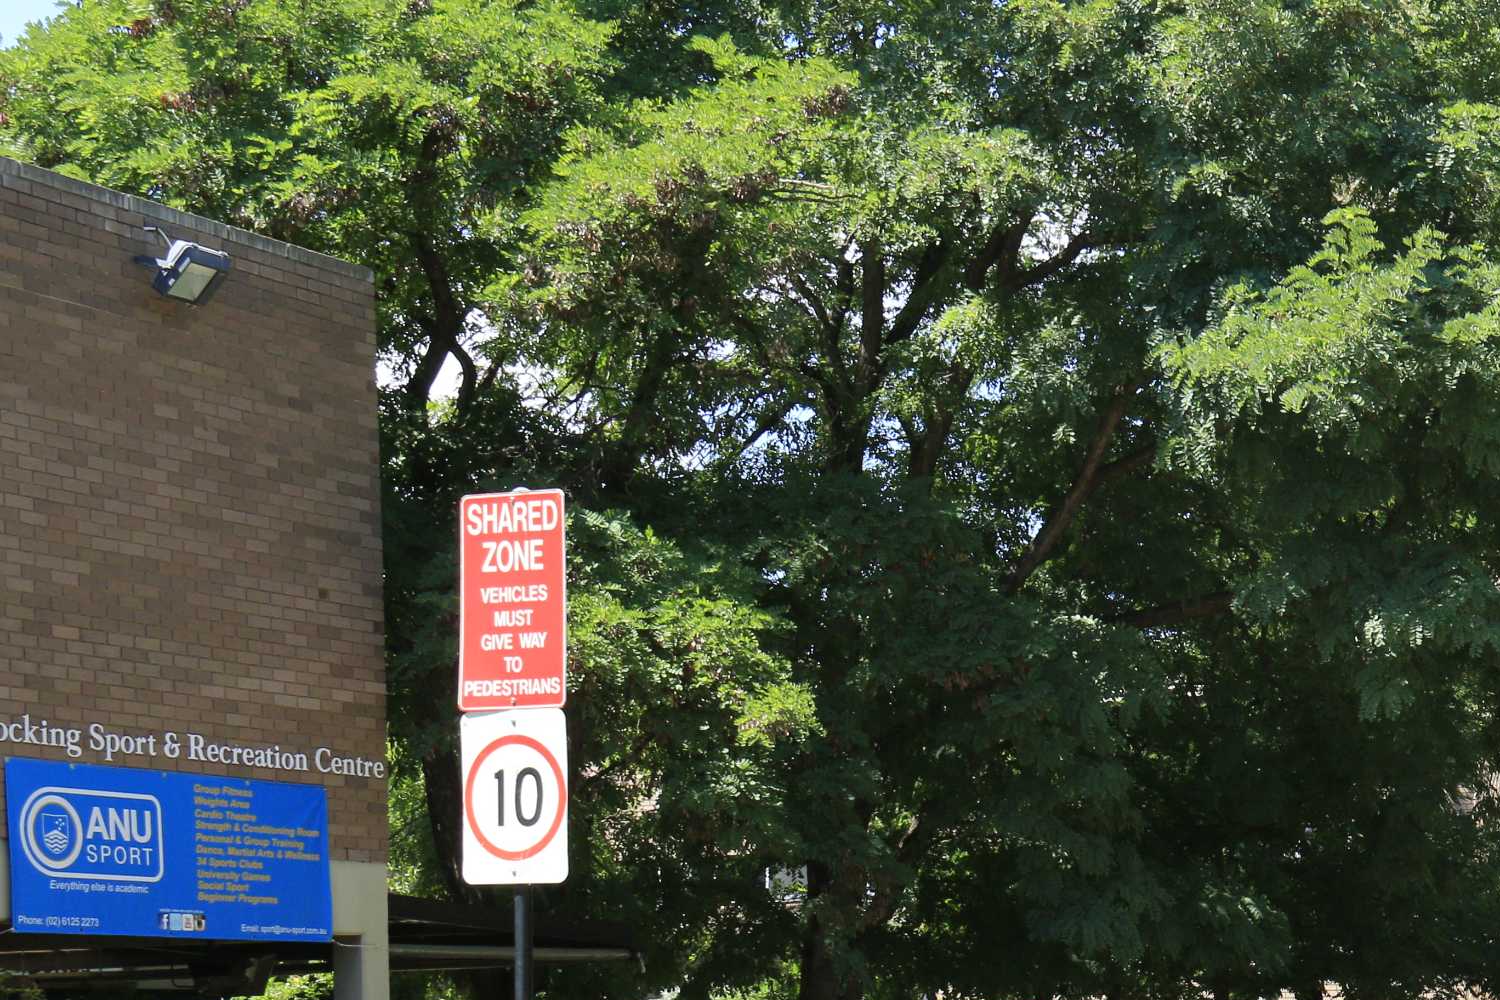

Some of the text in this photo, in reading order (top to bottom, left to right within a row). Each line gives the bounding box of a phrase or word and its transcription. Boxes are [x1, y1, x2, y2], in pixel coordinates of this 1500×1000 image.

[466, 499, 558, 536] SHARED
[481, 539, 544, 573] ZONE
[480, 584, 548, 604] VEHICLES
[494, 609, 533, 627] MUST
[481, 631, 547, 651] GIVE WAY
[503, 656, 523, 673] TO
[464, 676, 561, 697] PEDESTRIANS
[89, 723, 157, 761] Sport
[164, 732, 181, 759] &
[187, 733, 309, 771] Recreation
[315, 747, 385, 778] Centre
[194, 784, 254, 797] Group Fitness
[493, 766, 544, 827] 10
[194, 796, 228, 808] Weights
[195, 809, 224, 819] Cardio
[86, 806, 152, 844] ANU
[195, 820, 232, 832] Strength
[234, 823, 241, 831] &
[242, 823, 296, 838] Conditioning
[196, 832, 234, 843] Personal
[243, 836, 270, 847] Group
[272, 838, 304, 850] Training
[87, 844, 153, 867] SPORT
[227, 847, 256, 857] Martial
[257, 848, 274, 857] Arts
[209, 858, 237, 868] Sports
[239, 860, 263, 869] Clubs
[197, 869, 271, 882] University Games
[50, 880, 90, 893] Everything
[91, 883, 106, 891] else
[115, 885, 149, 893] academic
[198, 880, 249, 892] Social Sport
[197, 891, 278, 904] Beginner Programs
[18, 915, 99, 928] Phone: (02) 6125 2273
